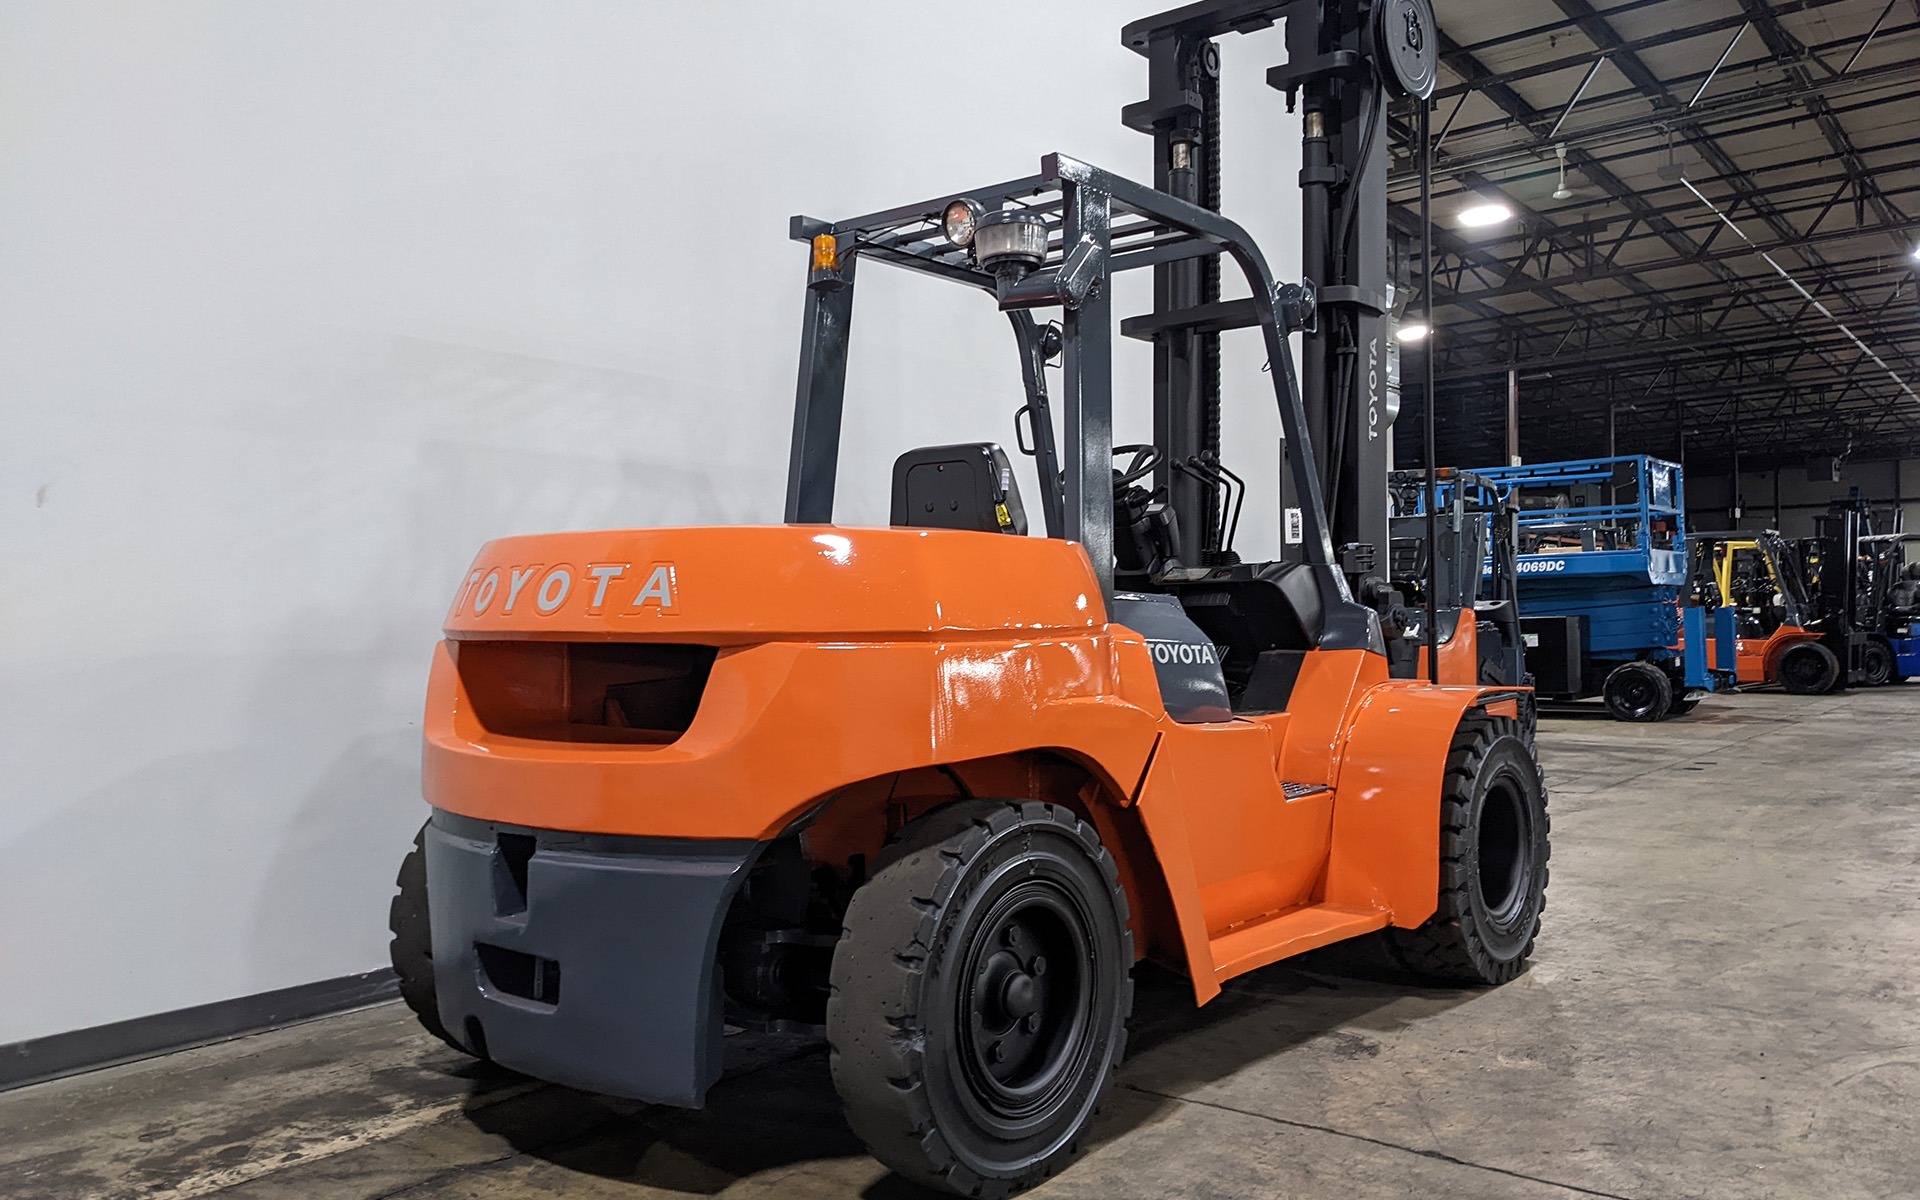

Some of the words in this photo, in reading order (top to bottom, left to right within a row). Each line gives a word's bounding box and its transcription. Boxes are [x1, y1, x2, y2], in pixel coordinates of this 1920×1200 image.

[1368, 337, 1378, 441] TOYOTA
[455, 562, 676, 616] TOYOTA
[1516, 561, 1565, 573] 4069DC
